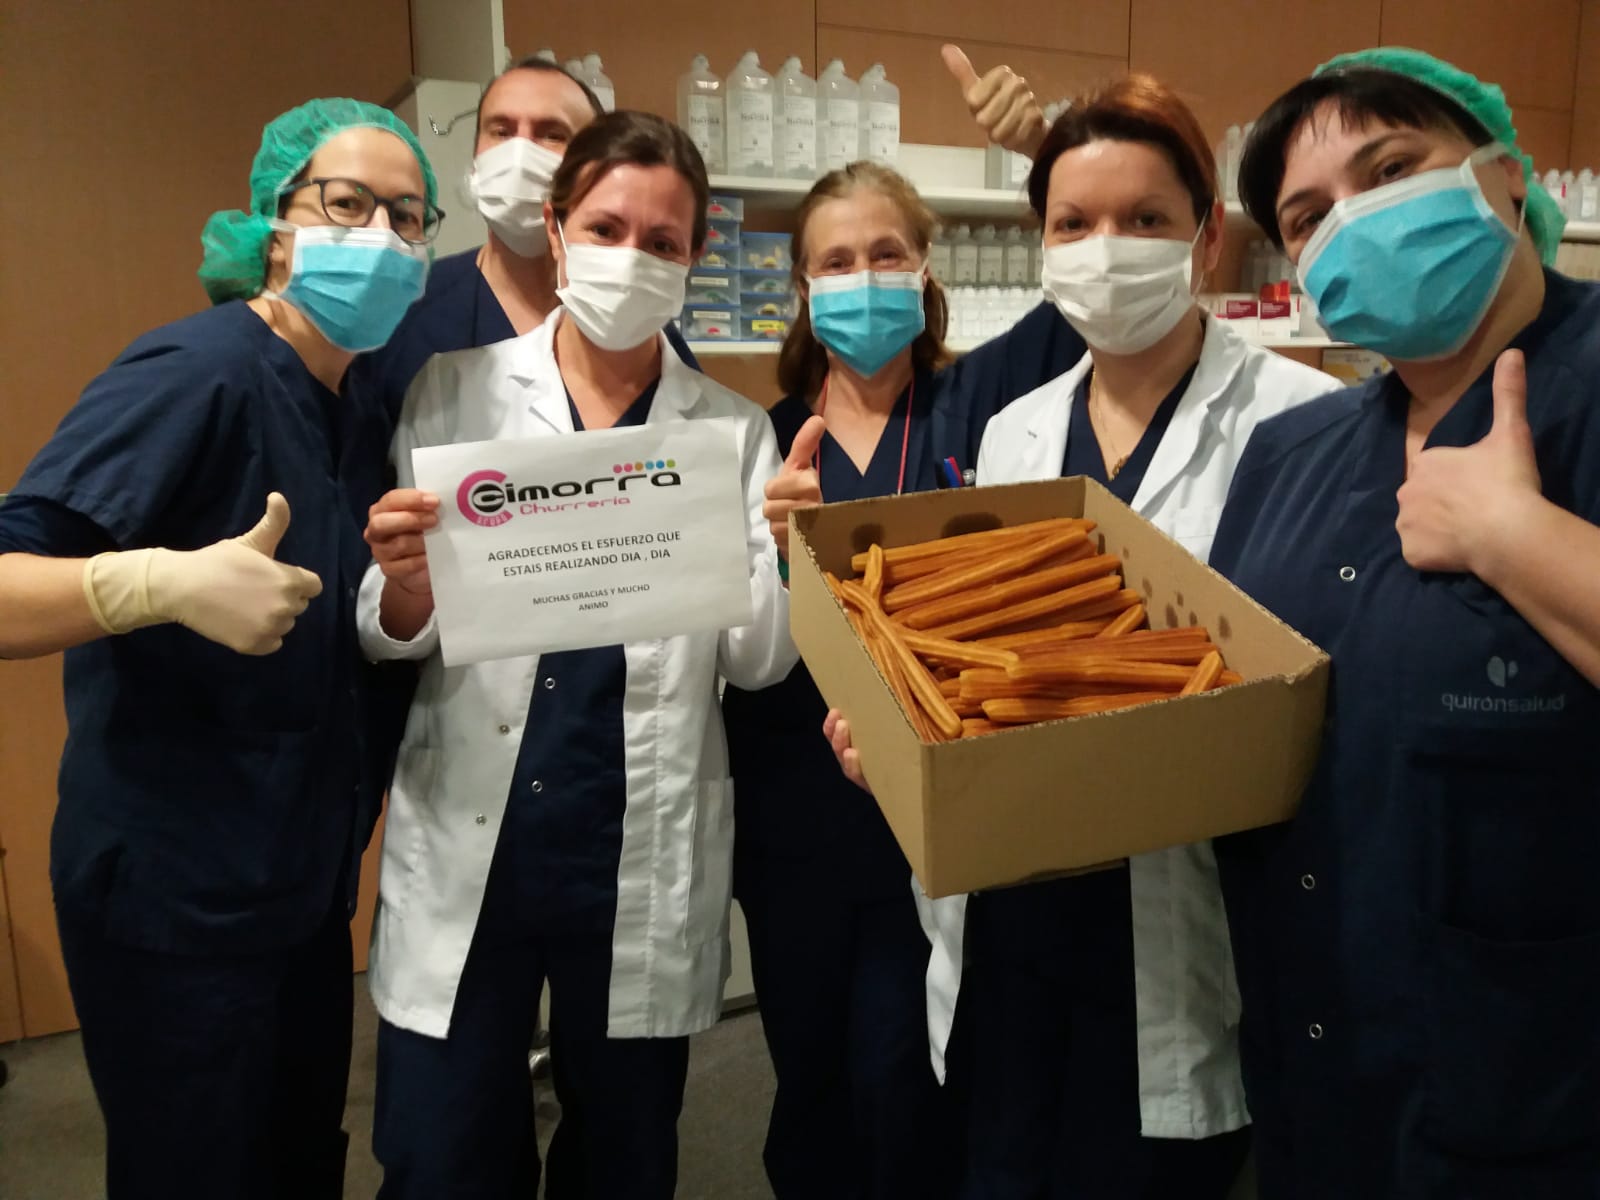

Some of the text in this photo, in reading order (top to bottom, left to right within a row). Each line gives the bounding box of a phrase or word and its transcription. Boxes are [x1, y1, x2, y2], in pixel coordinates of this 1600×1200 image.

[456, 469, 681, 527] Cimorra
[488, 531, 681, 562] AGRADECEMOS EL ESFUERZO QUE
[503, 563, 542, 577] ESTAIS
[545, 553, 618, 572] REALIZANDO
[621, 551, 641, 562] DIA
[651, 548, 671, 559] DIA
[533, 583, 651, 605] MUCHAS GRACIAS Y MUCHO
[579, 600, 609, 611] ANIMO
